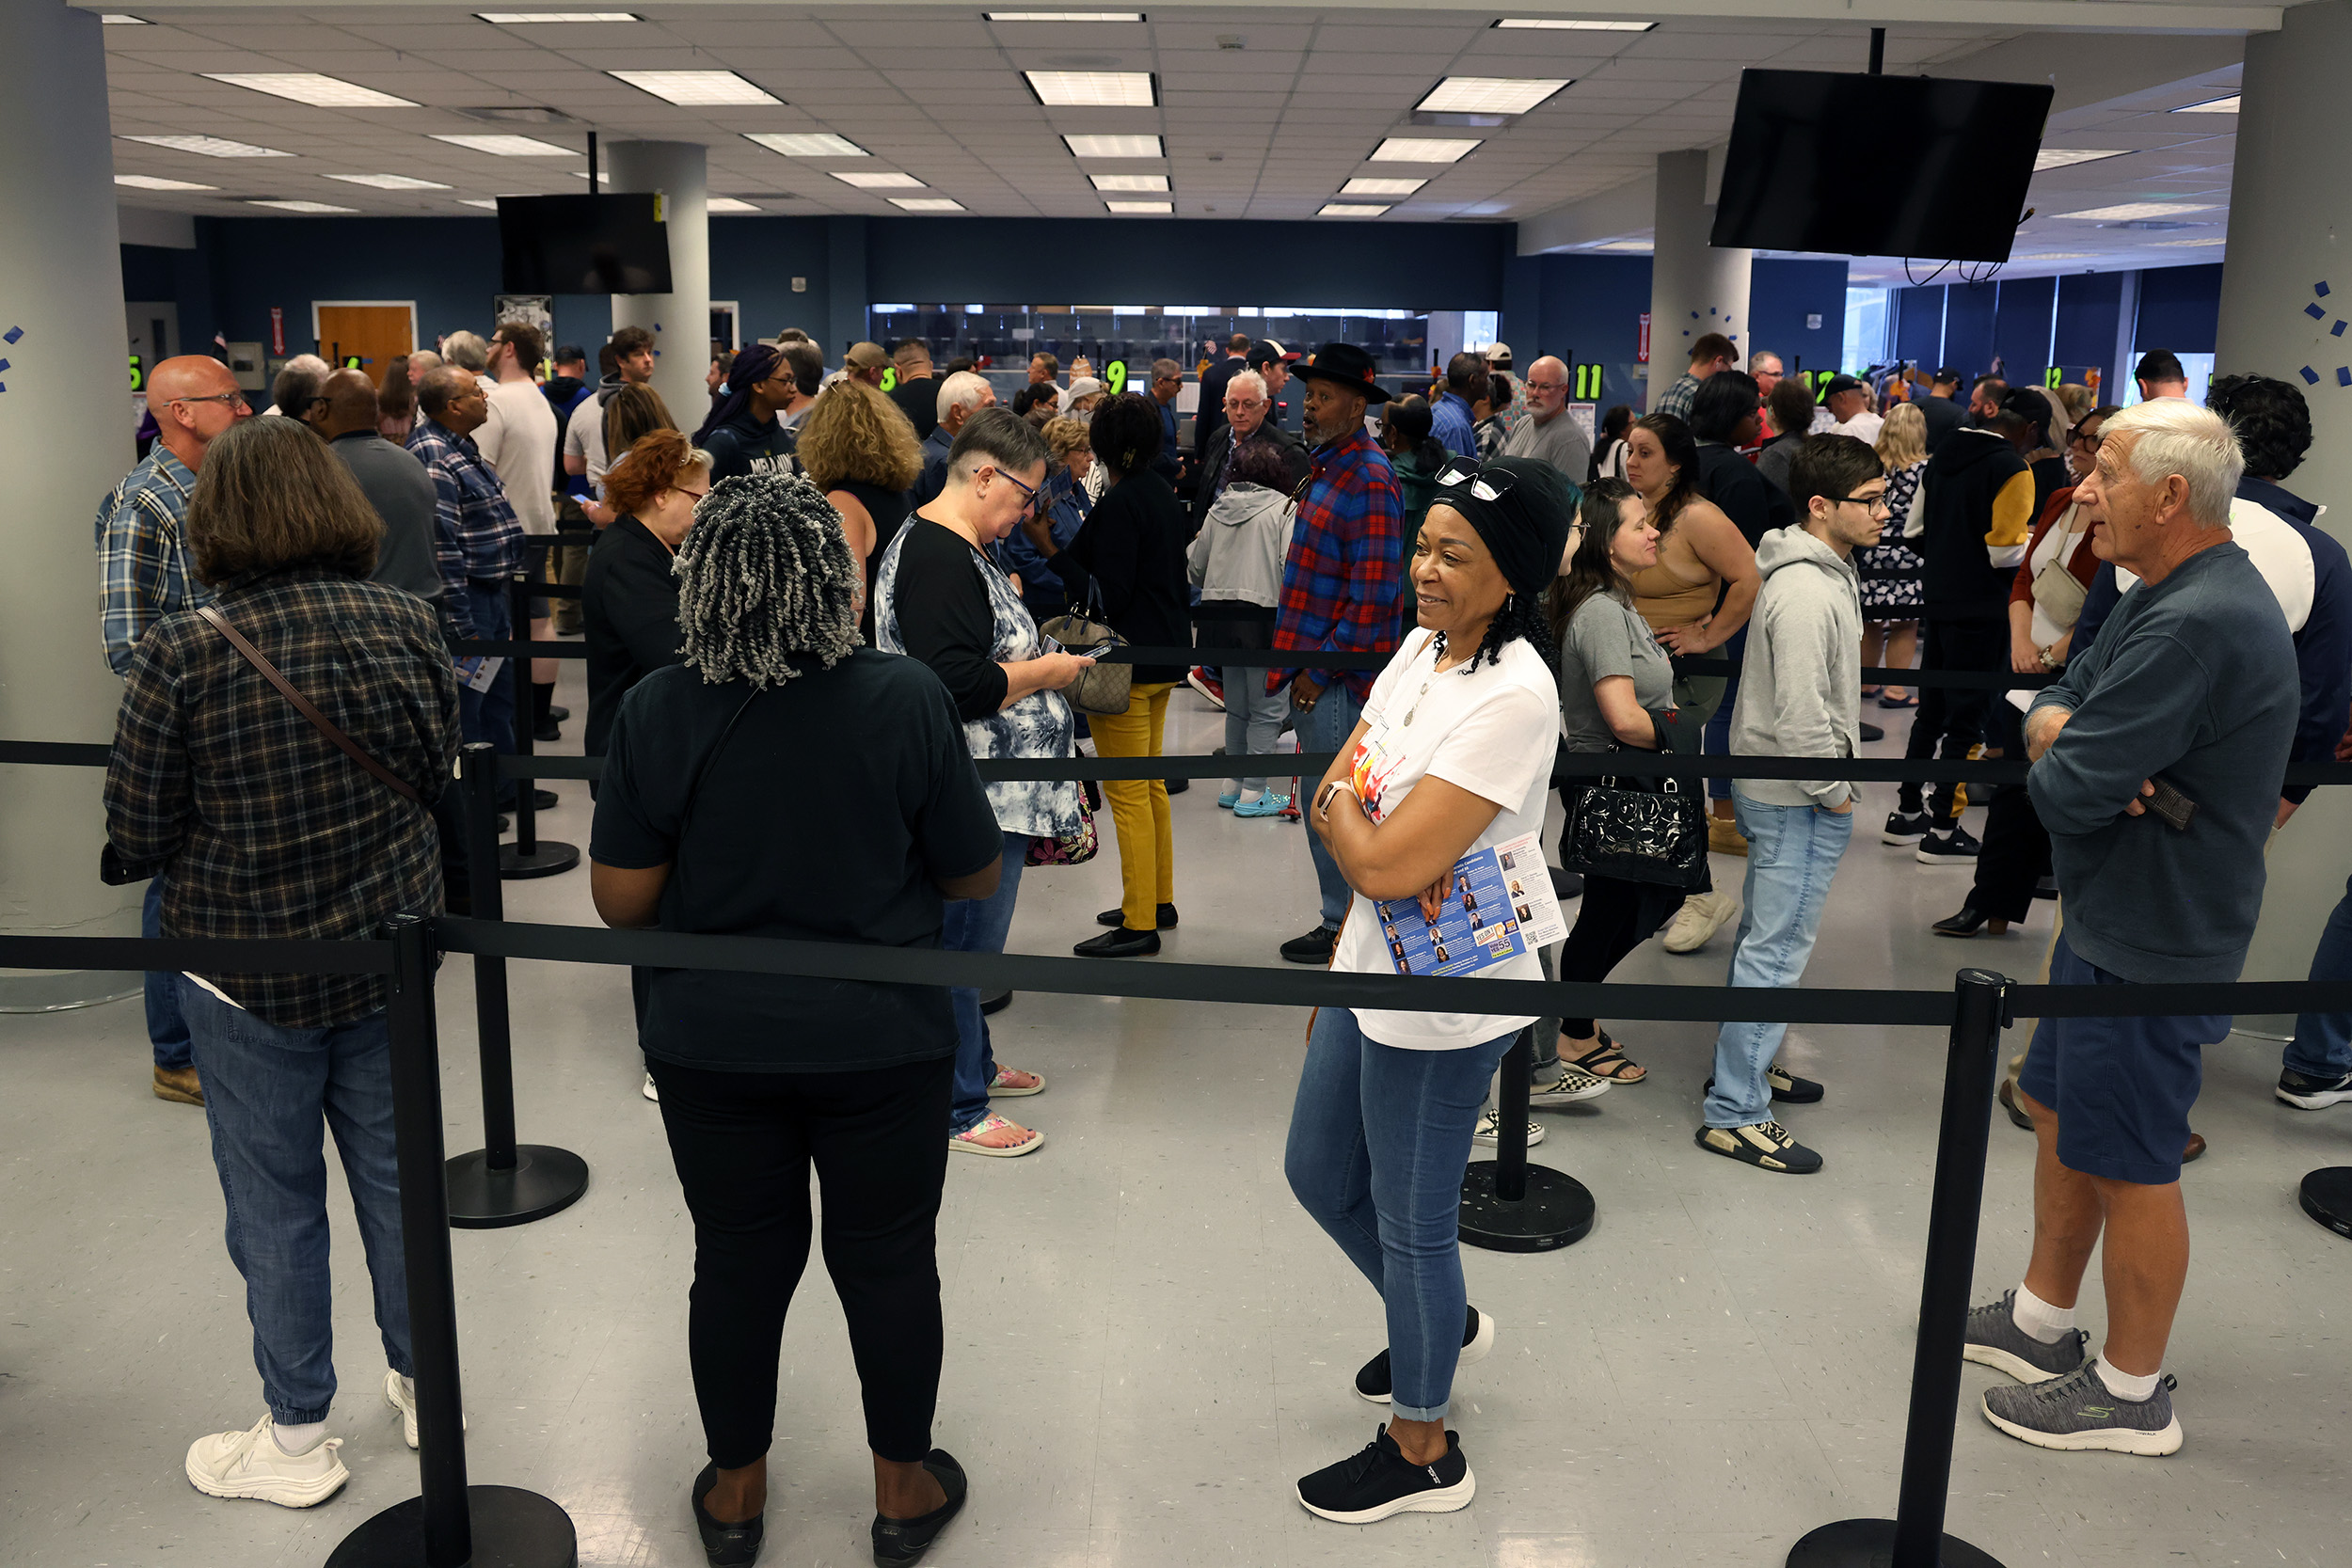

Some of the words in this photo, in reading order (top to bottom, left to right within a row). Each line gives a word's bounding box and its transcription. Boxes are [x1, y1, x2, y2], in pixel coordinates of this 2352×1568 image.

[1106, 360, 1126, 395] 9
[1576, 364, 1602, 399] 11
[1476, 932, 1485, 942] YES
[1498, 939, 1511, 950] 55
